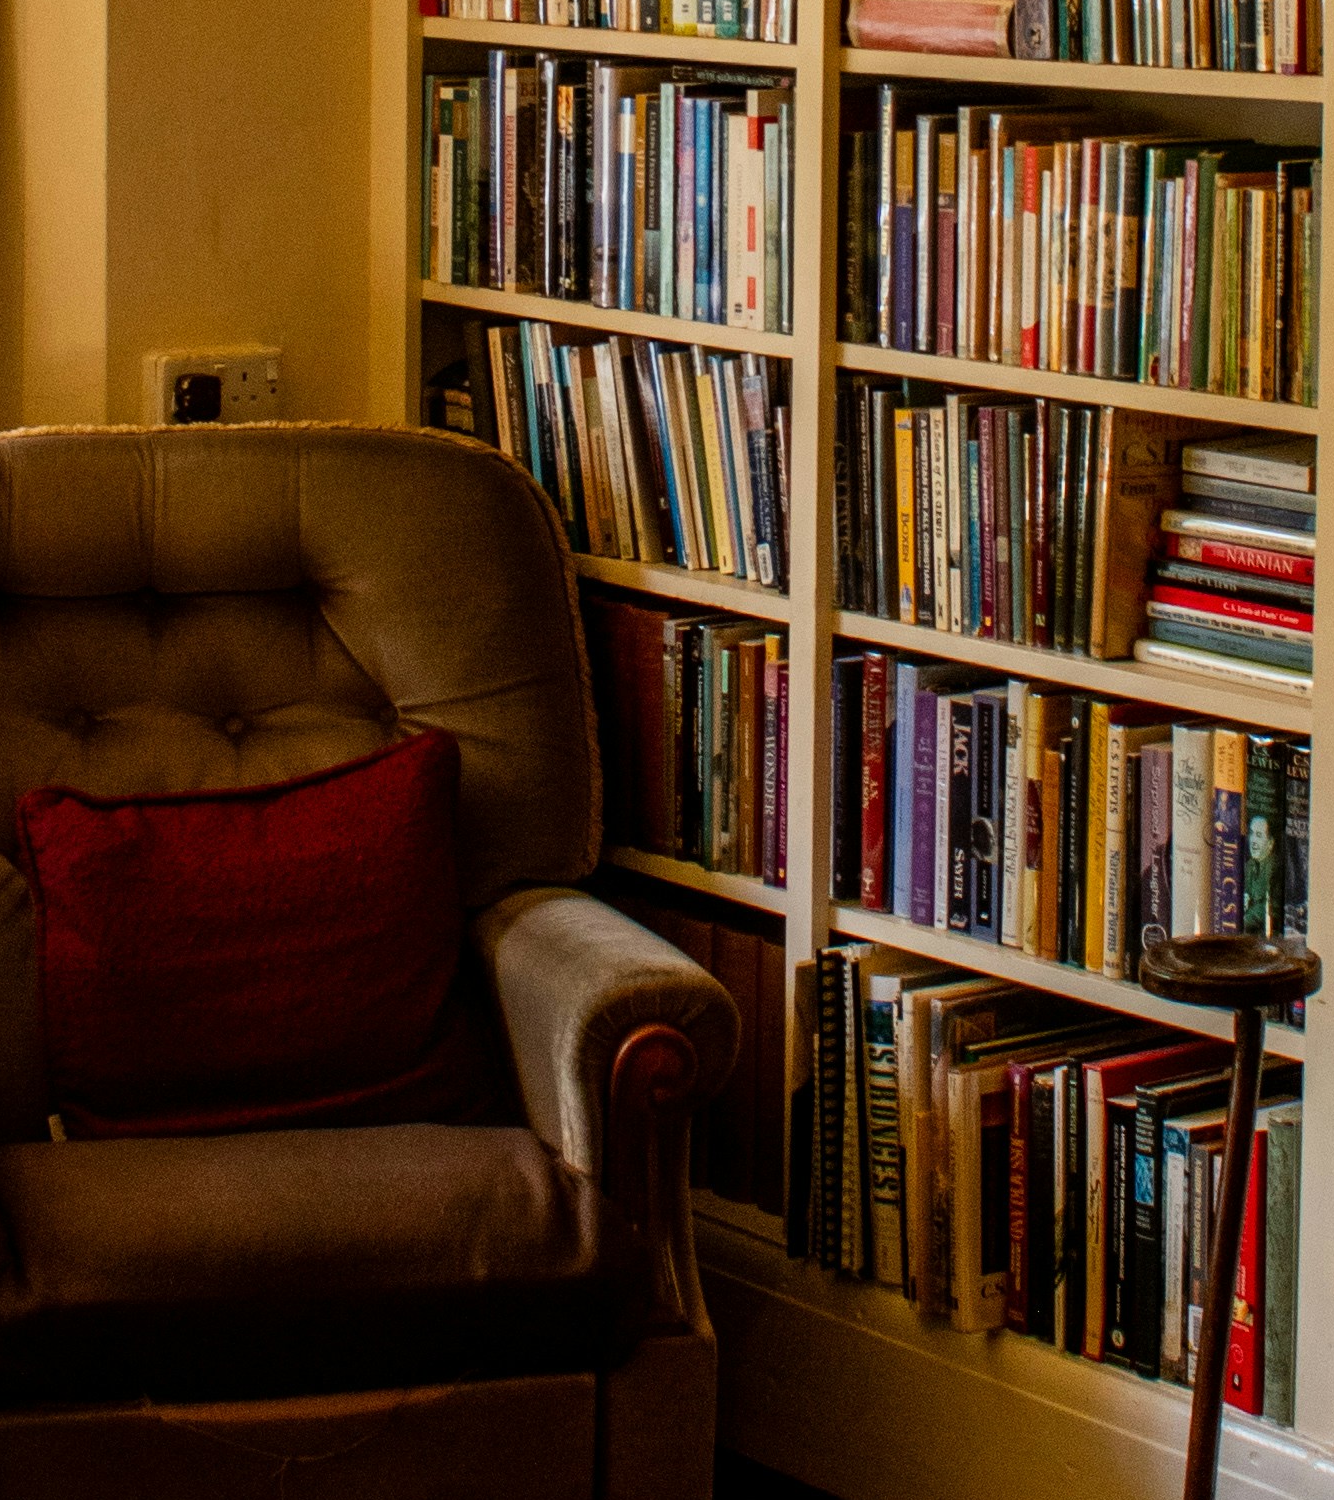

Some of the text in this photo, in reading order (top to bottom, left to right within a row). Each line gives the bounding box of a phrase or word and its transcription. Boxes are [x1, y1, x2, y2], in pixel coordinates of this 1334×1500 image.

[637, 137, 645, 189] CALLED
[920, 419, 927, 427] A
[933, 419, 941, 430] In
[933, 432, 942, 463] Search
[933, 466, 941, 476] of
[1120, 480, 1157, 496] From
[923, 532, 931, 595] CHRISTIANS
[1226, 547, 1293, 575] NARNIAN
[1237, 604, 1254, 616] Lewis
[1279, 612, 1299, 624] Corner
[1242, 622, 1265, 636] NARNIA
[765, 734, 775, 816] WONDER
[1247, 756, 1281, 772] LEWIS
[864, 764, 873, 810] WILSON
[953, 716, 971, 899] JACK SAYER
[1108, 764, 1120, 953] LEWIS Narrative Poems
[1150, 766, 1162, 918] Surprised Laughter
[869, 1046, 900, 1208] STRONGEST
[1009, 1135, 1025, 1240] JOSS ACKLAND
[1193, 1166, 1201, 1194] GUIDE
[1119, 1124, 1127, 1280] A HISTORY OF THE ENGLISH LANGUAGE
[1193, 1196, 1201, 1209] TO
[1193, 1226, 1201, 1270] ENGLISH
